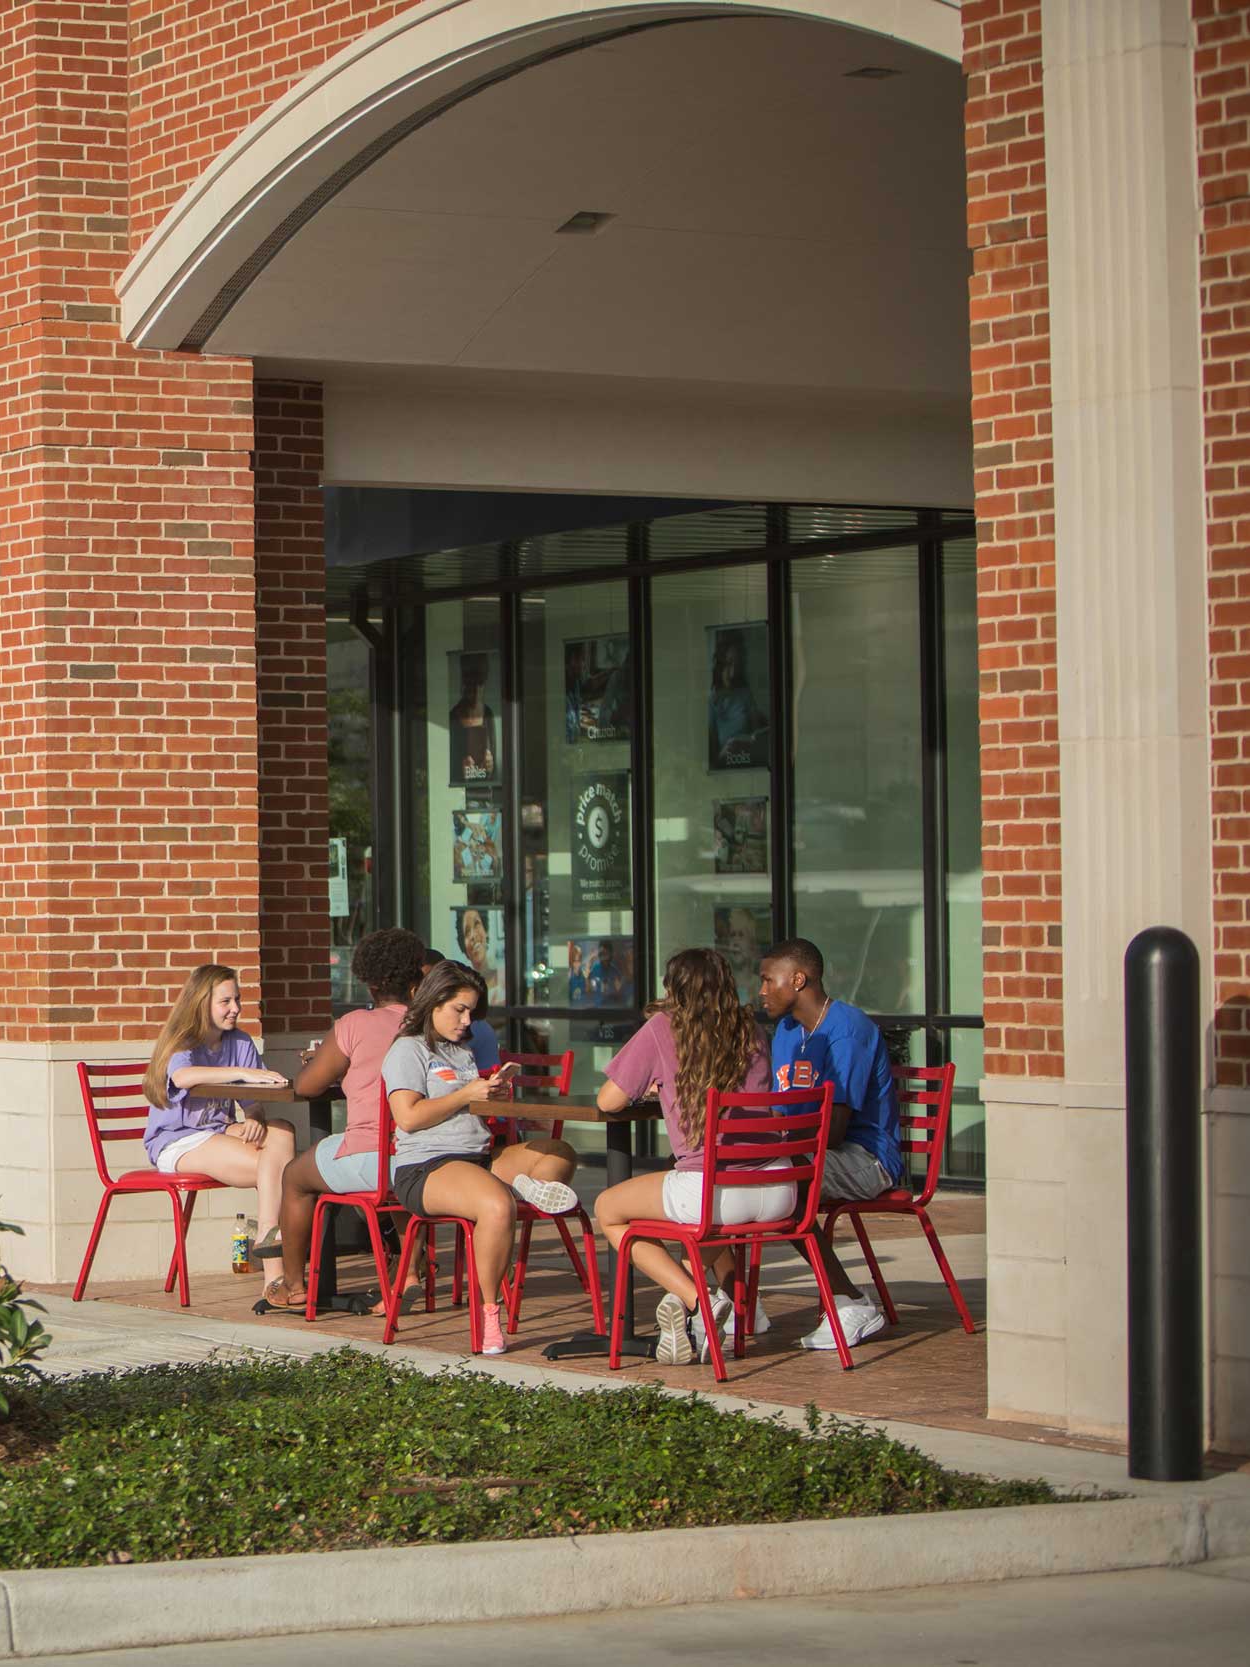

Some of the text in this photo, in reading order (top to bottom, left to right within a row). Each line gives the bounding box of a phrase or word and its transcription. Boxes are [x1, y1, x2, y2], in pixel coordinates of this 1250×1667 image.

[464, 765, 487, 779] Bibles
[576, 783, 622, 826] price match
[578, 844, 620, 872] promise
